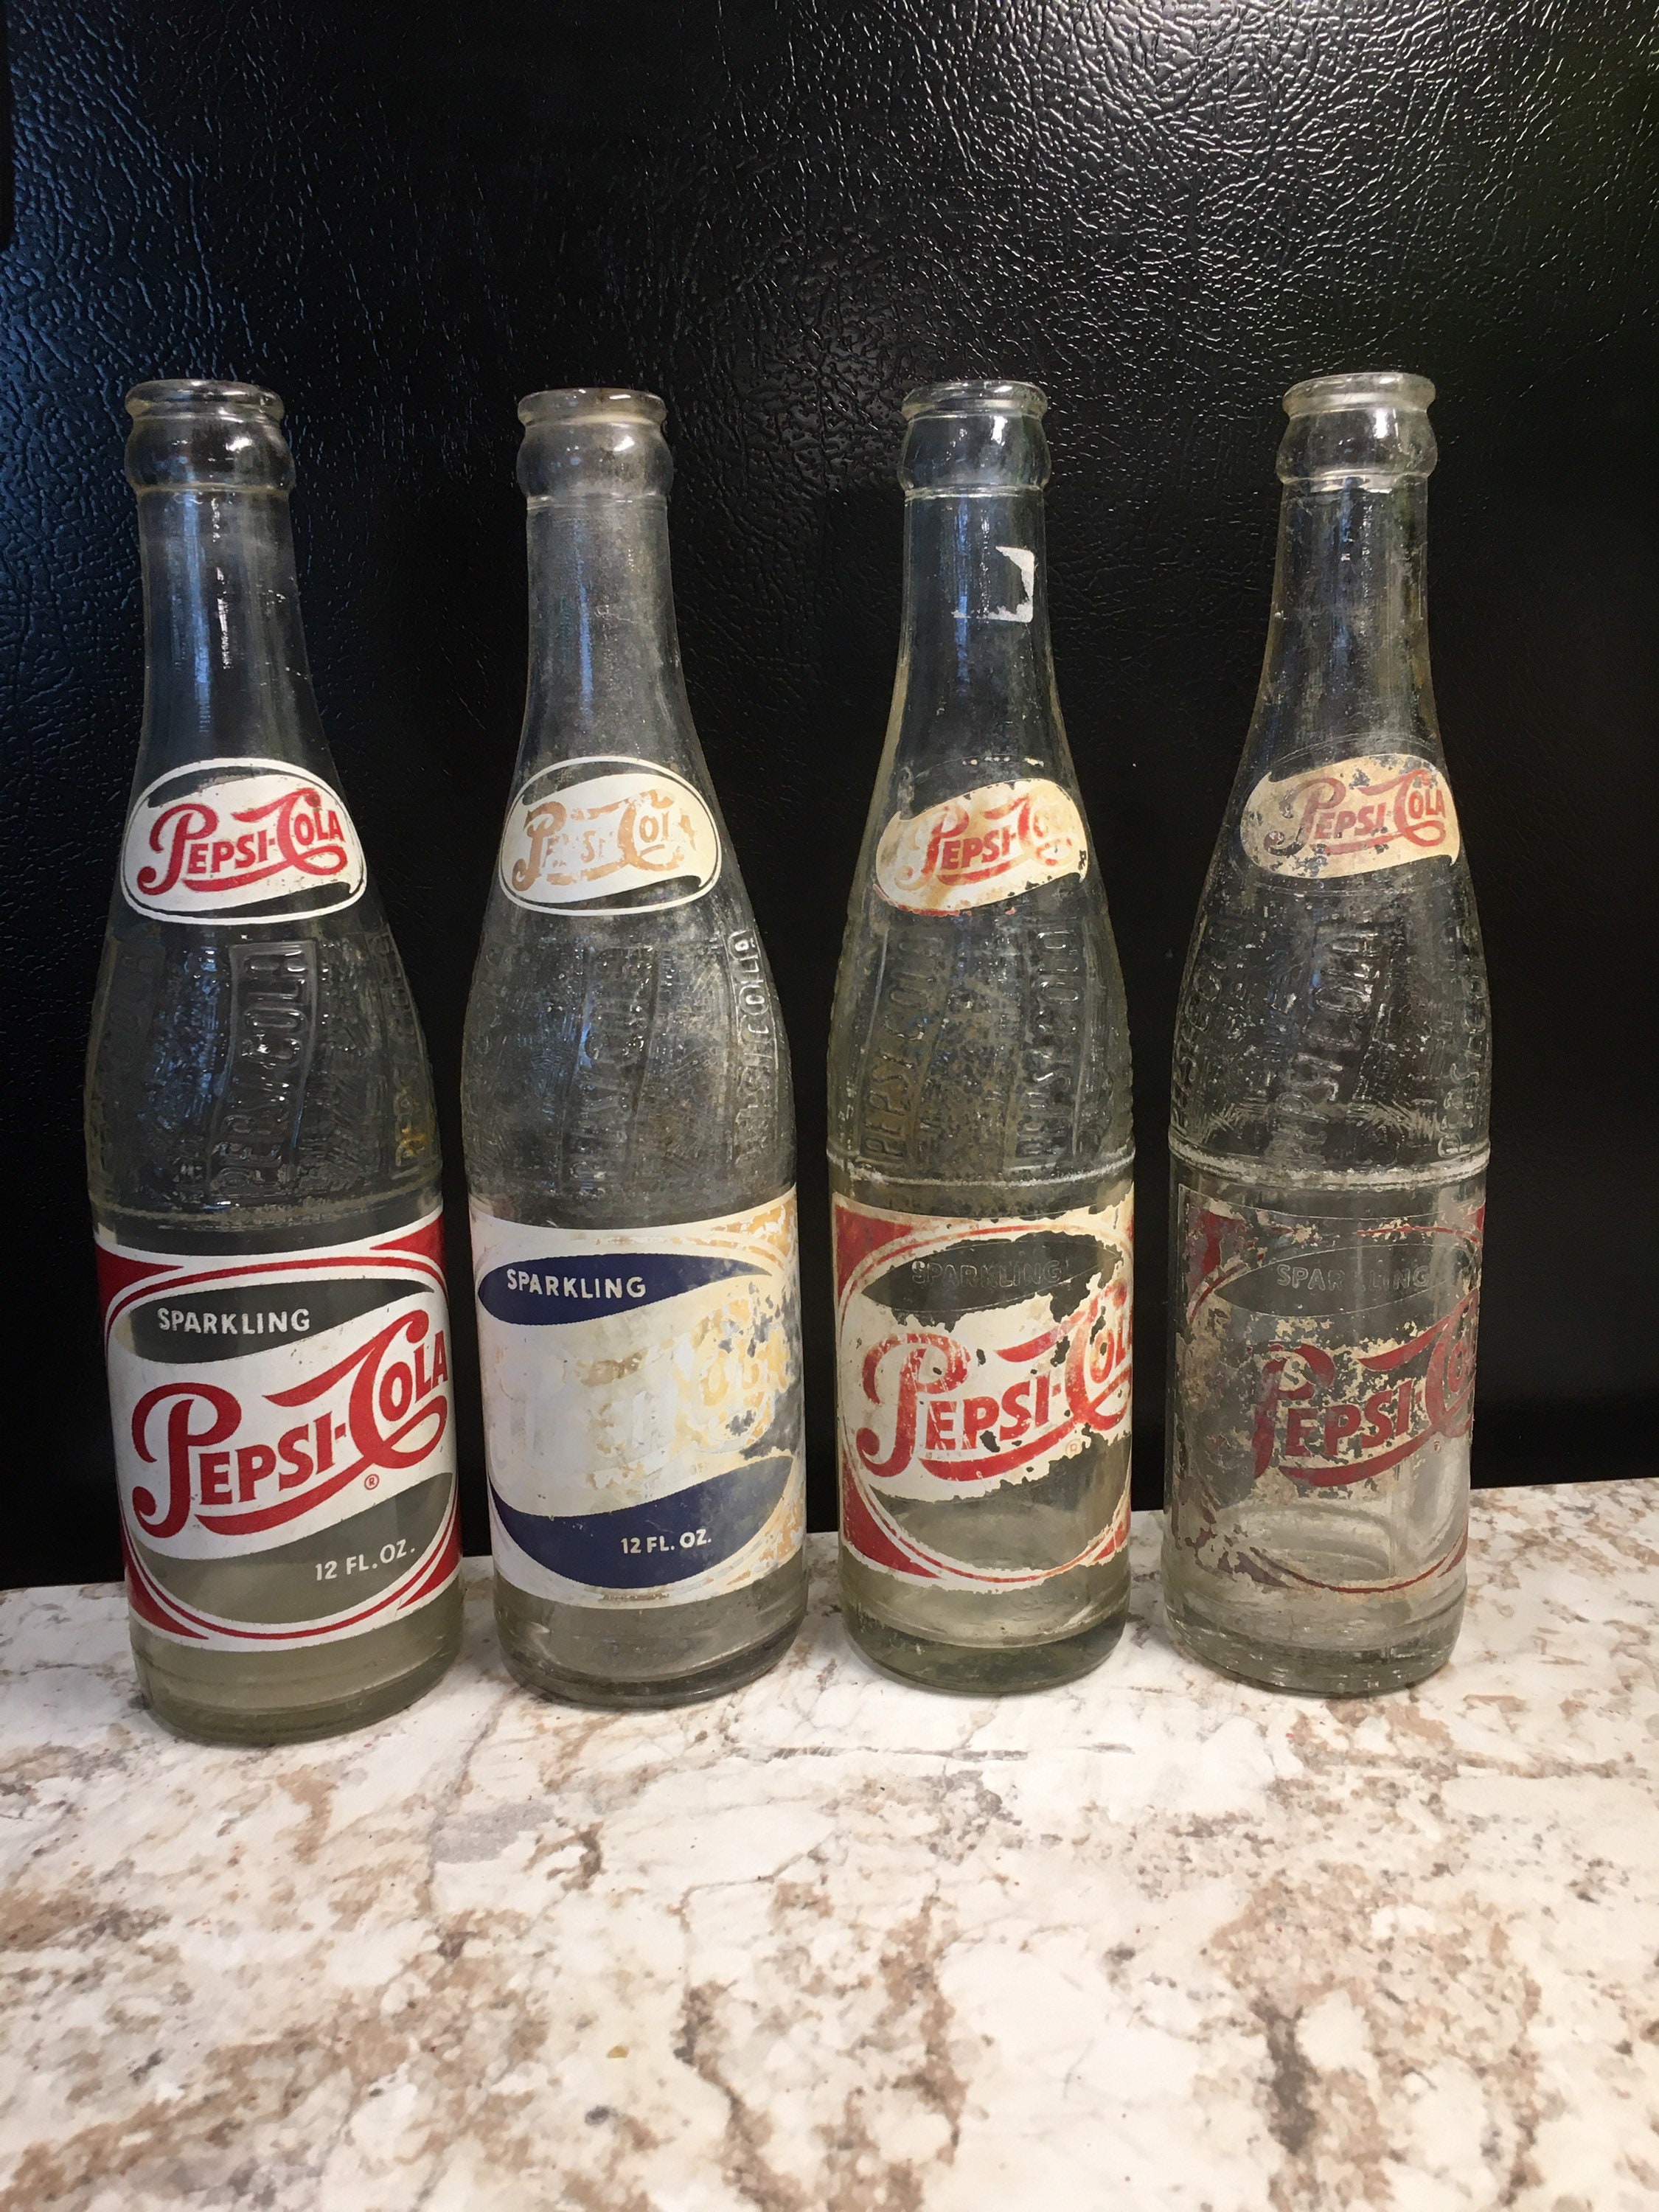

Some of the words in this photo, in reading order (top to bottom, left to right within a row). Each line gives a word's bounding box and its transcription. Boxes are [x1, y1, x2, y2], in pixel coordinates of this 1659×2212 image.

[137, 787, 348, 895] PEPSI-COLA
[506, 1269, 647, 1298] SPARKLING
[1276, 1264, 1430, 1291] SPARLING
[157, 1307, 311, 1335] SPARKLING
[131, 1310, 448, 1538] PEPSI-COLA
[621, 1537, 641, 1554] 12
[647, 1536, 675, 1553] FL.
[679, 1528, 712, 1548] OZ.
[315, 1560, 338, 1581] 12
